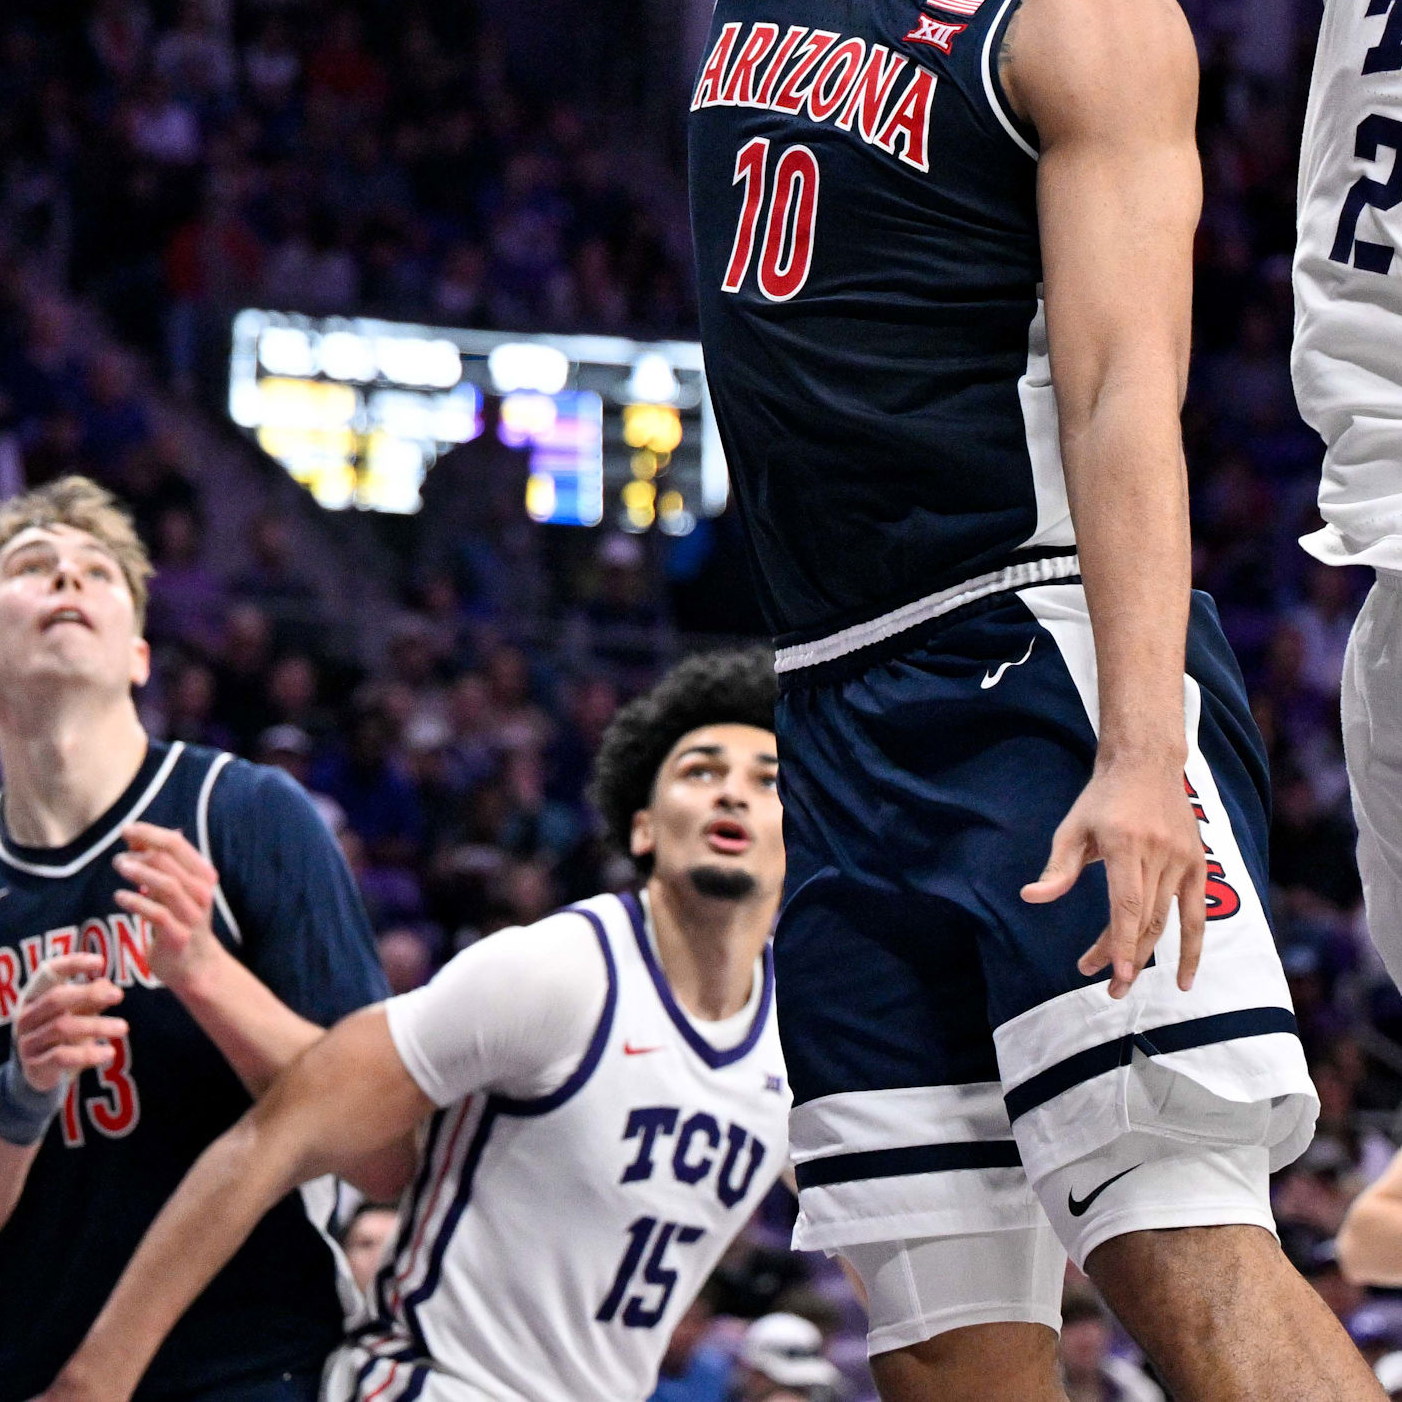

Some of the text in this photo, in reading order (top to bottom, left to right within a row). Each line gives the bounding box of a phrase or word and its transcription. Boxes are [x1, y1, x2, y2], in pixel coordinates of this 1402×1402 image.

[905, 14, 965, 52] XII
[689, 22, 939, 174] ARIZONA
[721, 136, 820, 303] 10
[620, 1106, 766, 1210] TCU
[594, 1215, 706, 1329] 15
